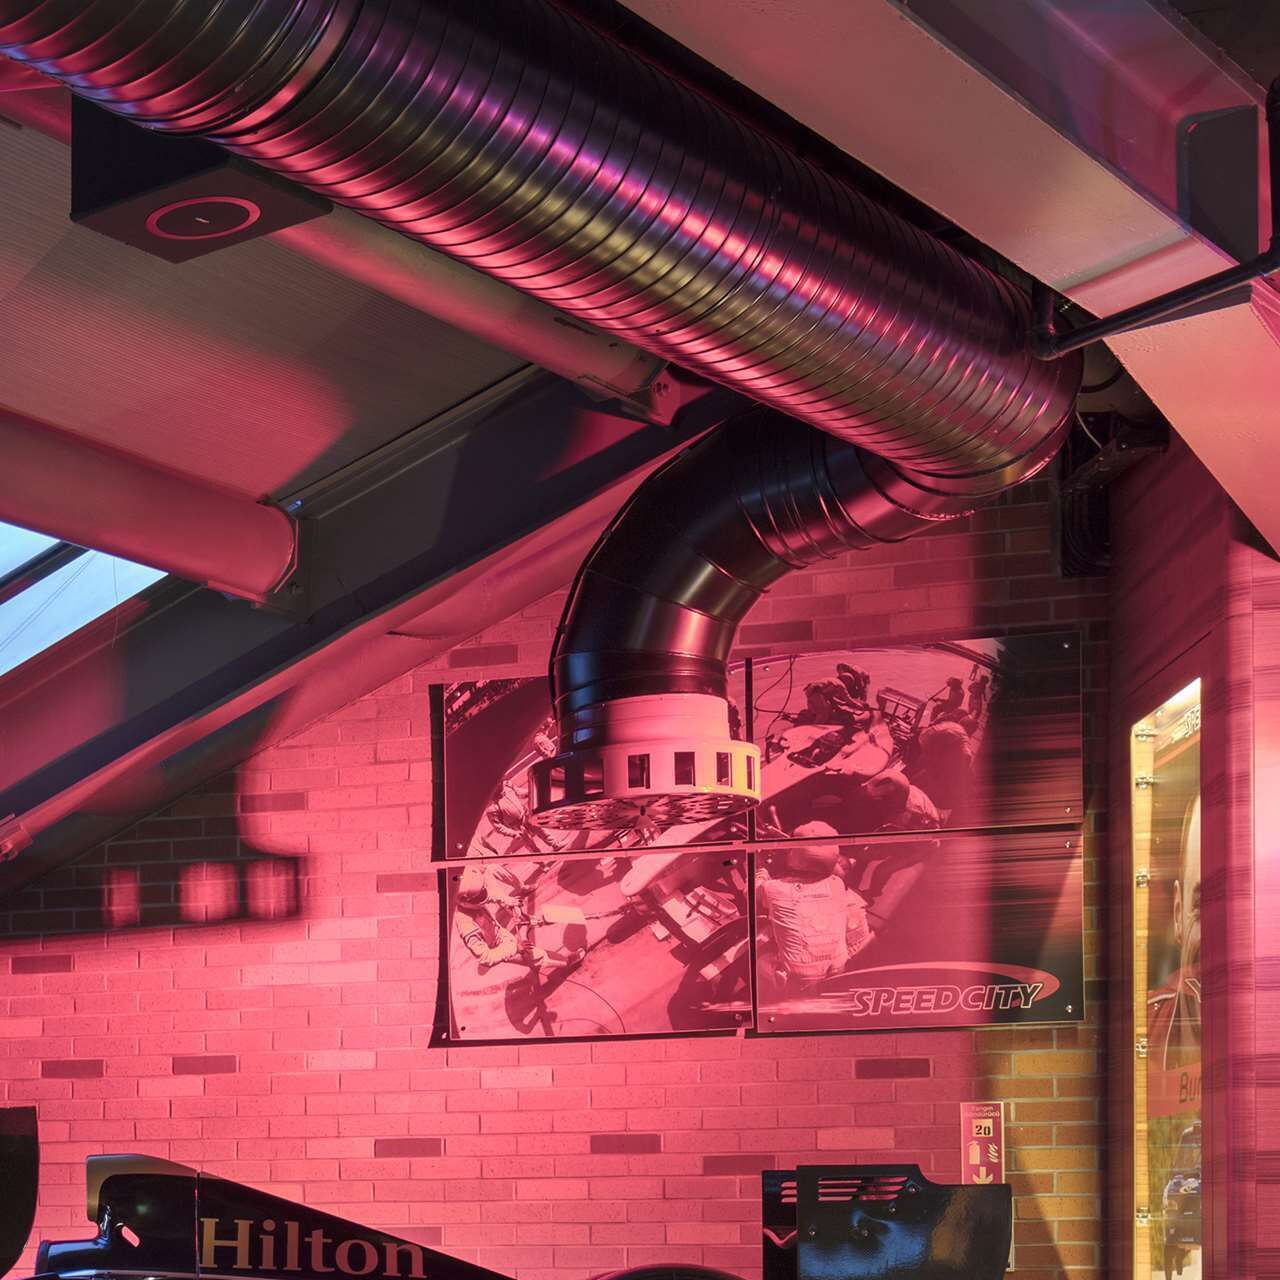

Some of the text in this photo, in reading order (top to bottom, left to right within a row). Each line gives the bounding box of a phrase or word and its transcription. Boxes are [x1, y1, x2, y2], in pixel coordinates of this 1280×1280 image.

[852, 983, 1043, 1017] SPEEDCITY
[975, 1124, 991, 1136] 20
[198, 1217, 428, 1279] Hilton
